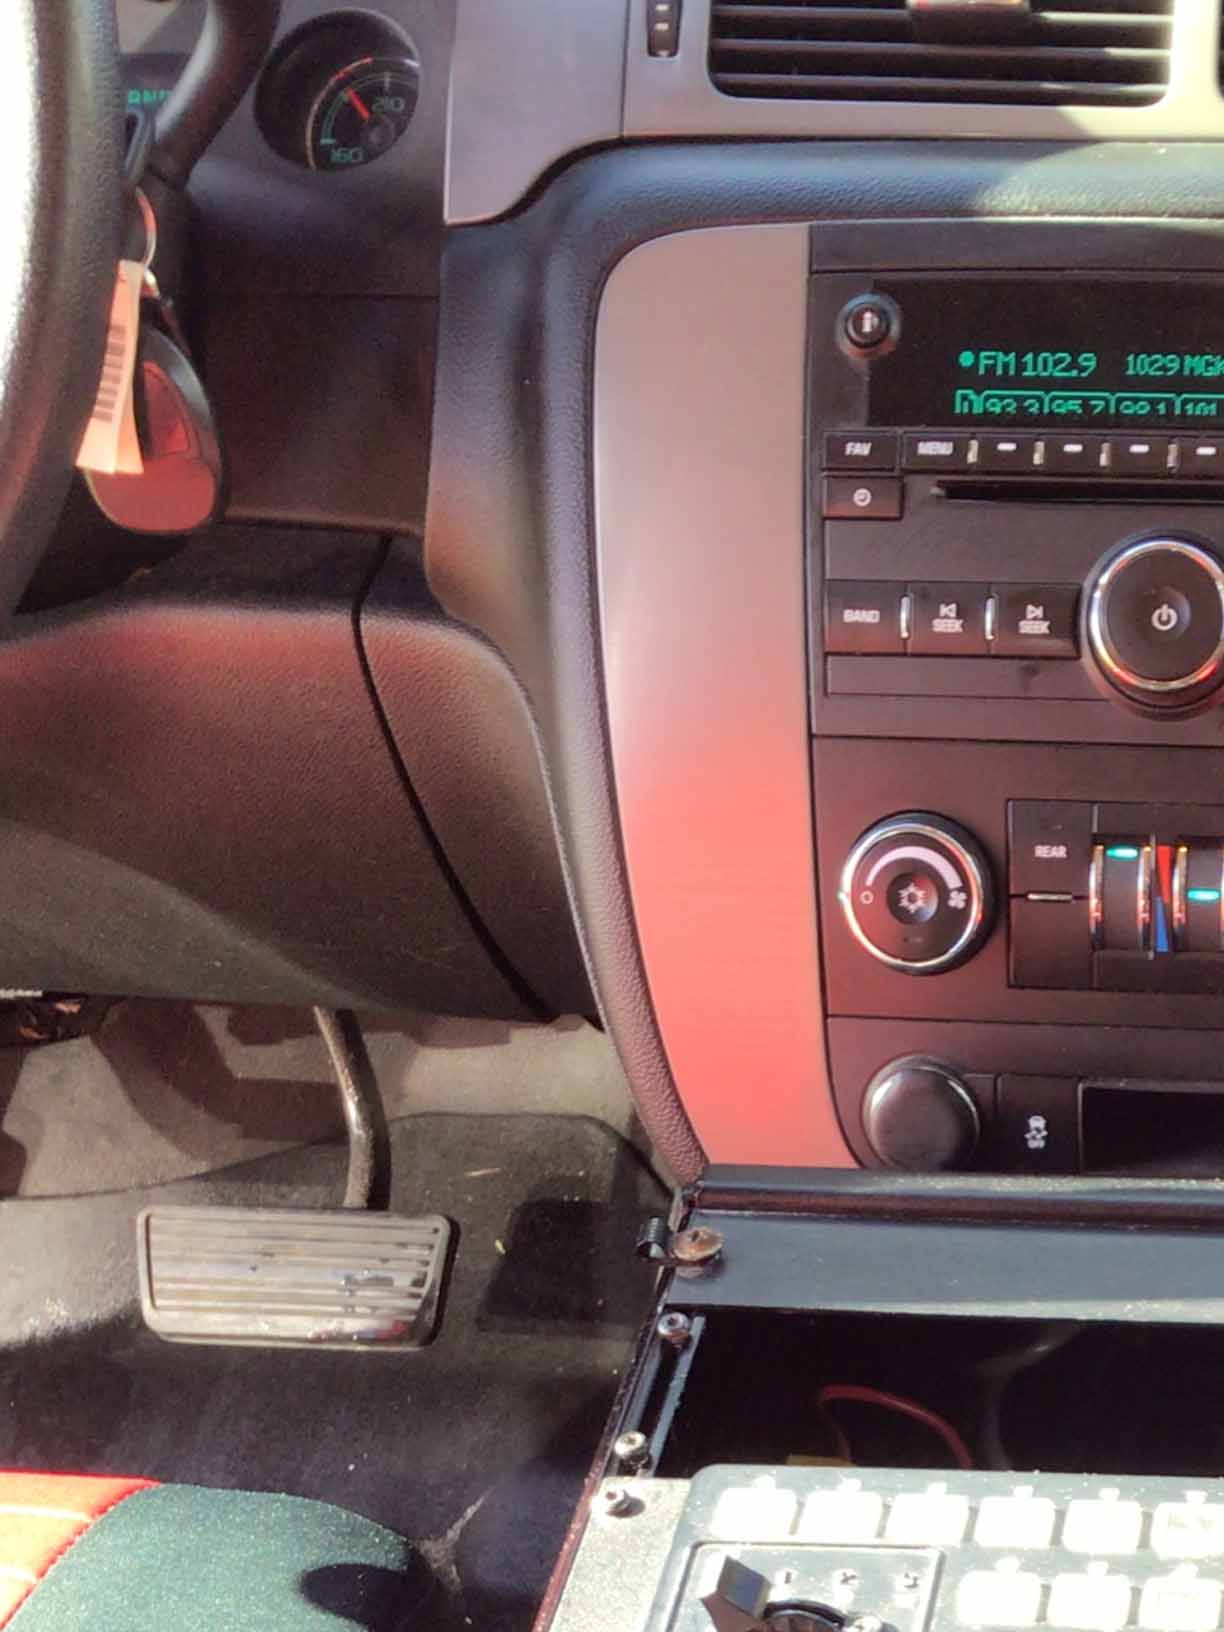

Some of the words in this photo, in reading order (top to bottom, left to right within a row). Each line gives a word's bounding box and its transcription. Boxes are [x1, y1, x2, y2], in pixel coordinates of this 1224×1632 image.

[977, 350, 1017, 376] FM
[1021, 351, 1098, 377] 102.9
[1125, 352, 1180, 377] 1029
[843, 609, 880, 624] BAND
[932, 618, 965, 633] SEEK
[1018, 620, 1050, 634] SEEK
[1034, 845, 1068, 859] REAR
